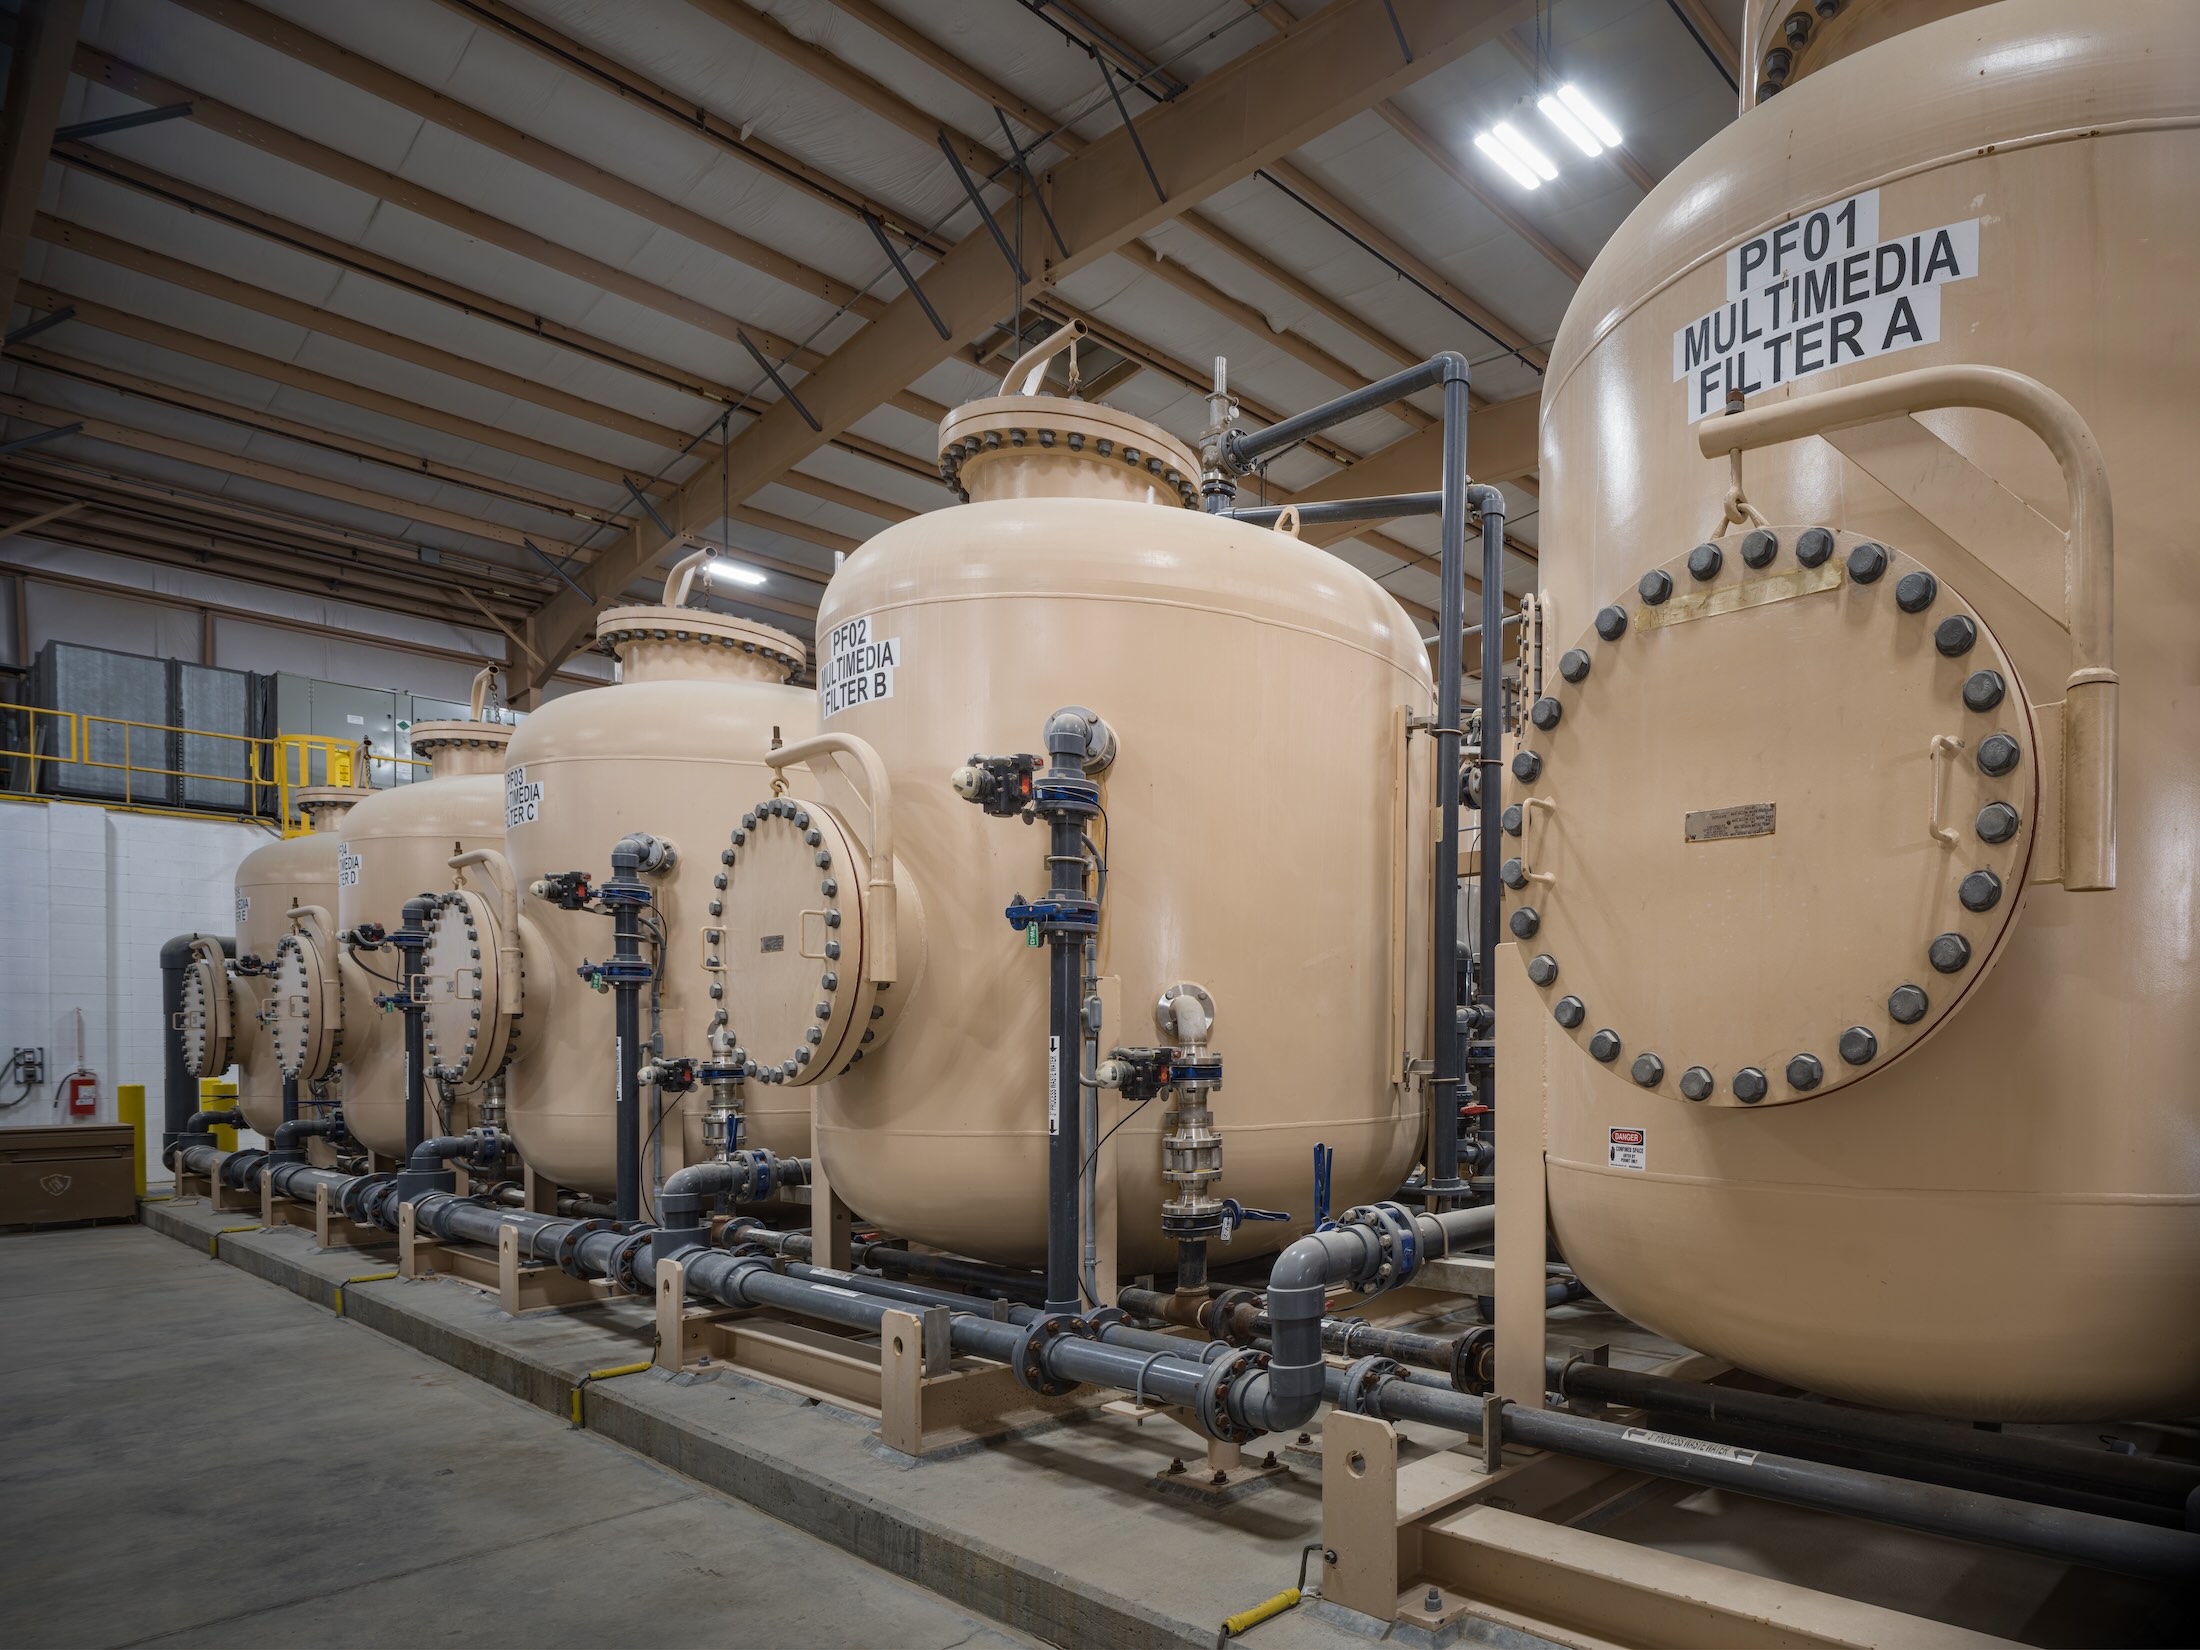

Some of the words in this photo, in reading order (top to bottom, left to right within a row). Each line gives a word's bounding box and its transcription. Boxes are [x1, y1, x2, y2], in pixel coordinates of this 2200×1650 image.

[1740, 199, 1856, 292] PF01
[1685, 229, 1961, 372] MULTIMEDIA
[1701, 311, 1865, 415] FILTER
[1881, 296, 1923, 350] A
[833, 619, 867, 656] PF02
[825, 676, 869, 717] FILTER
[874, 672, 887, 698] B
[526, 803, 534, 821] C
[350, 870, 356, 884] D
[1614, 1133, 1639, 1142] DANGER
[1655, 1434, 1684, 1447] PROCESS
[1683, 1439, 1706, 1452] WASTE
[1705, 1443, 1729, 1456] WATER
